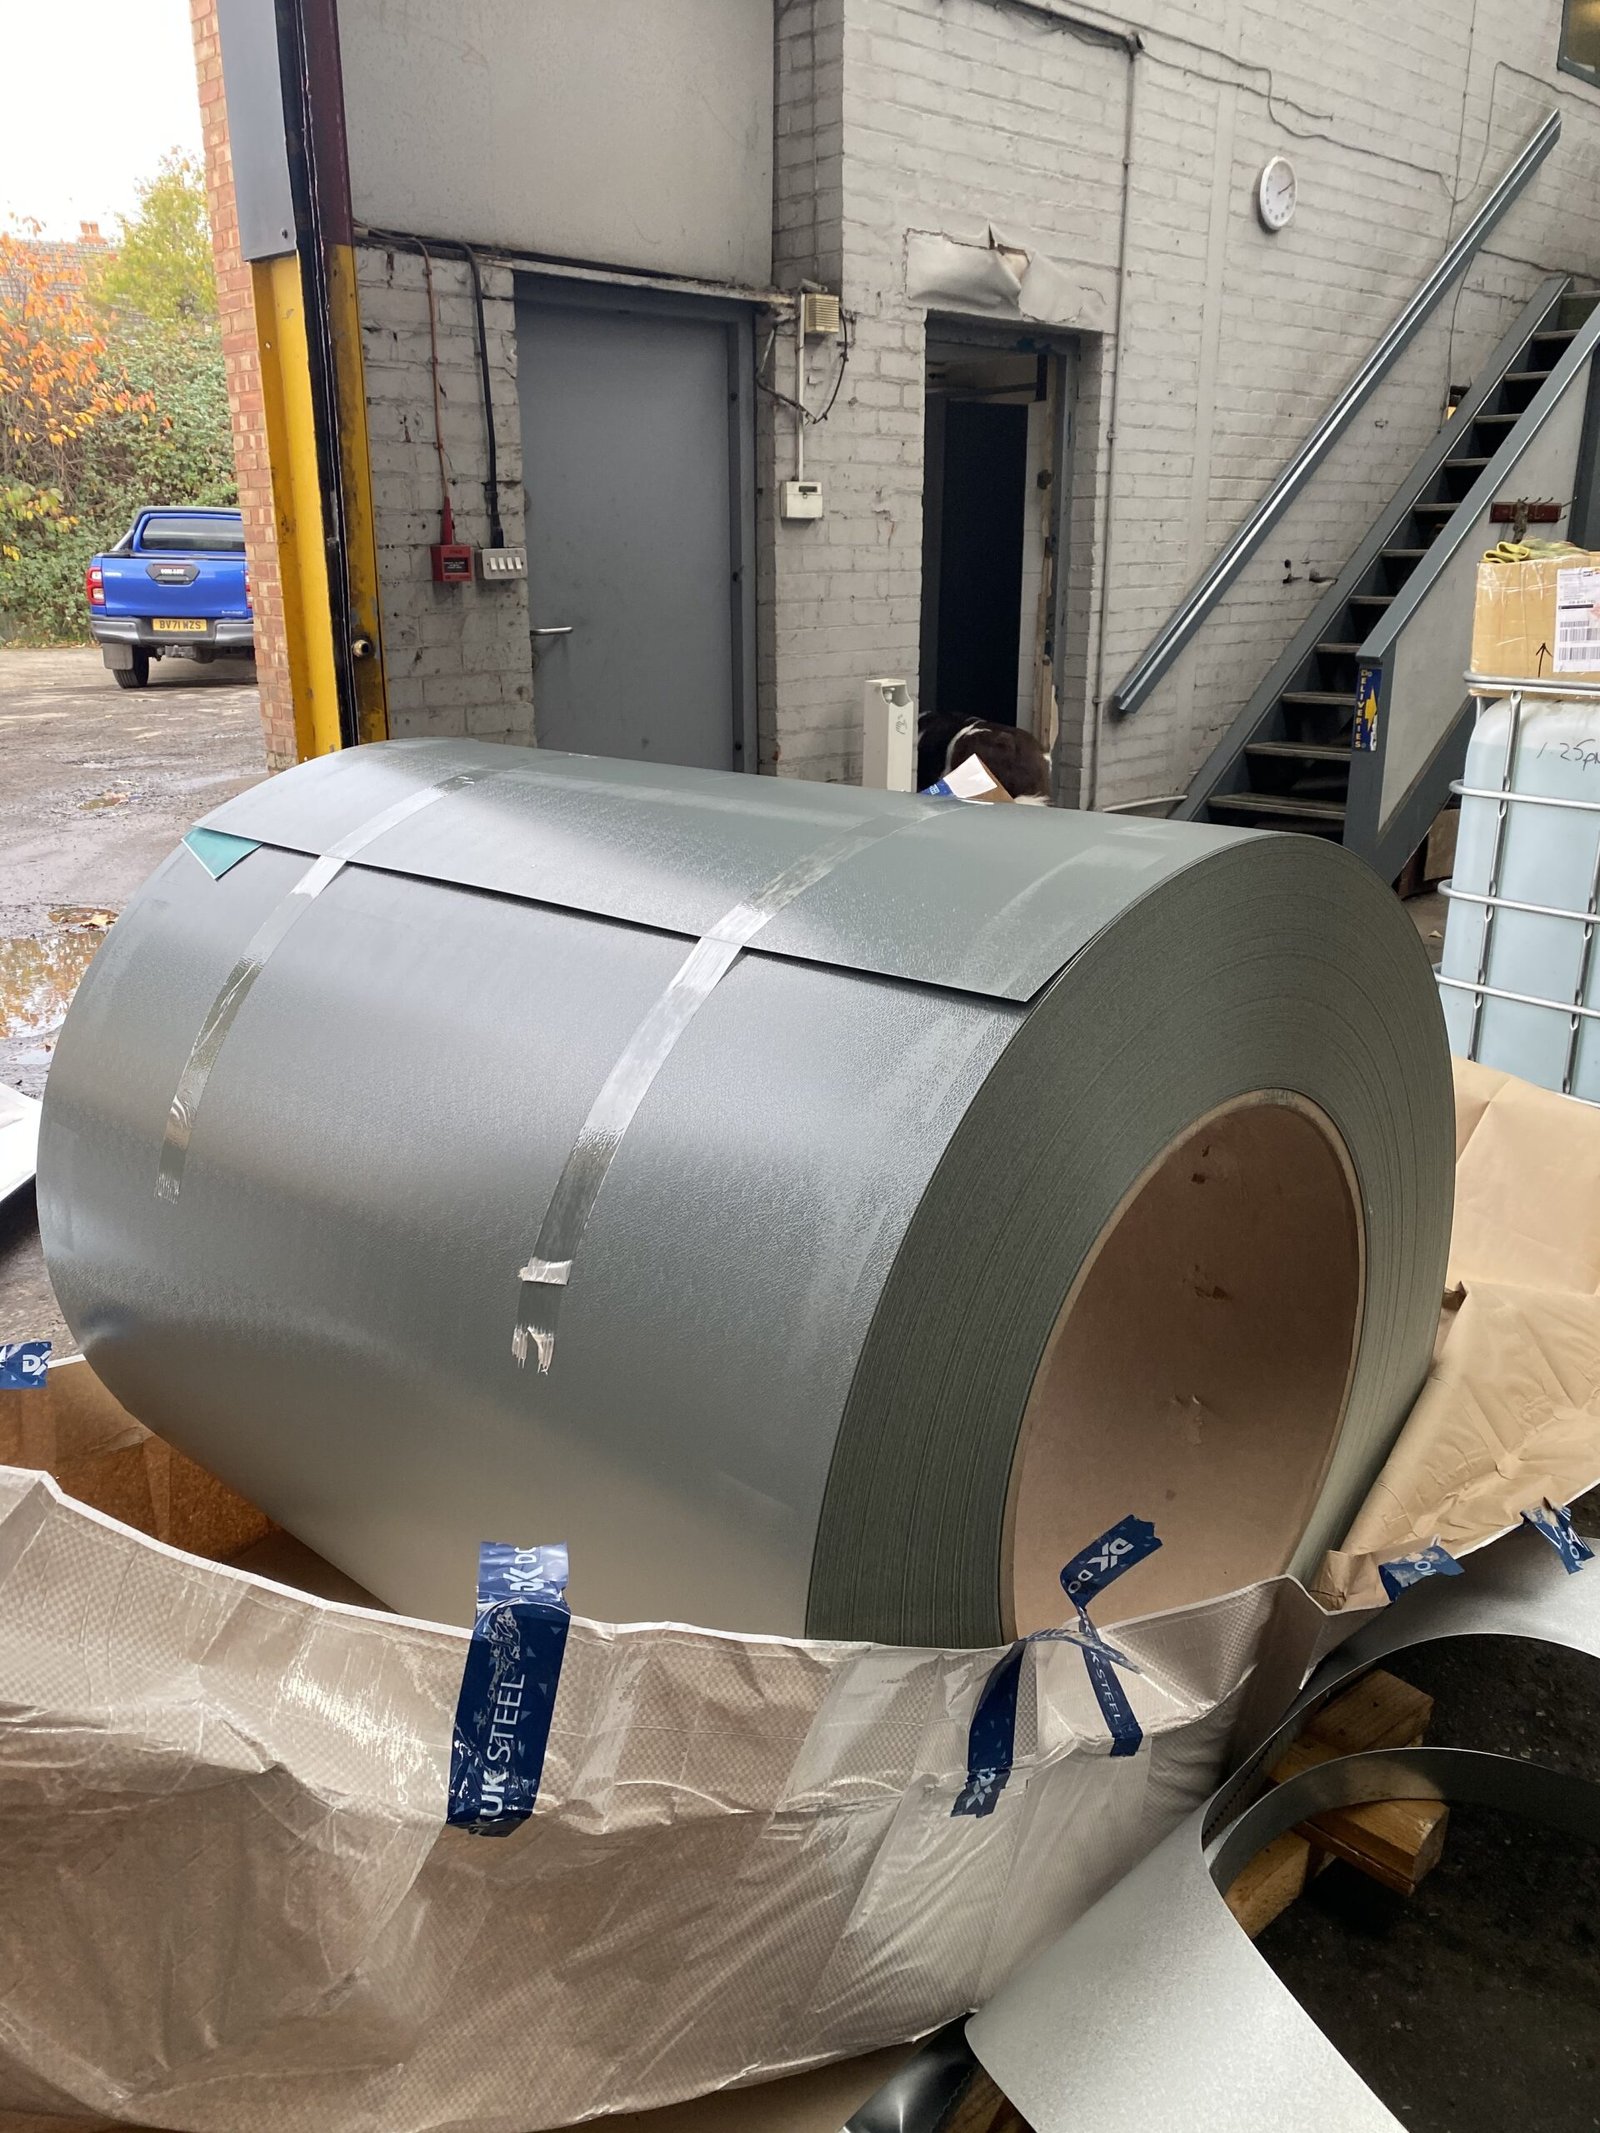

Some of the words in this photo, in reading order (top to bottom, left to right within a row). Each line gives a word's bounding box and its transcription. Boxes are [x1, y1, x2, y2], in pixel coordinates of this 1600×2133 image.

[160, 620, 181, 630] BV71
[183, 620, 202, 630] WZS
[1355, 669, 1368, 748] DELIVERIES
[486, 1673, 526, 1763] STEEL
